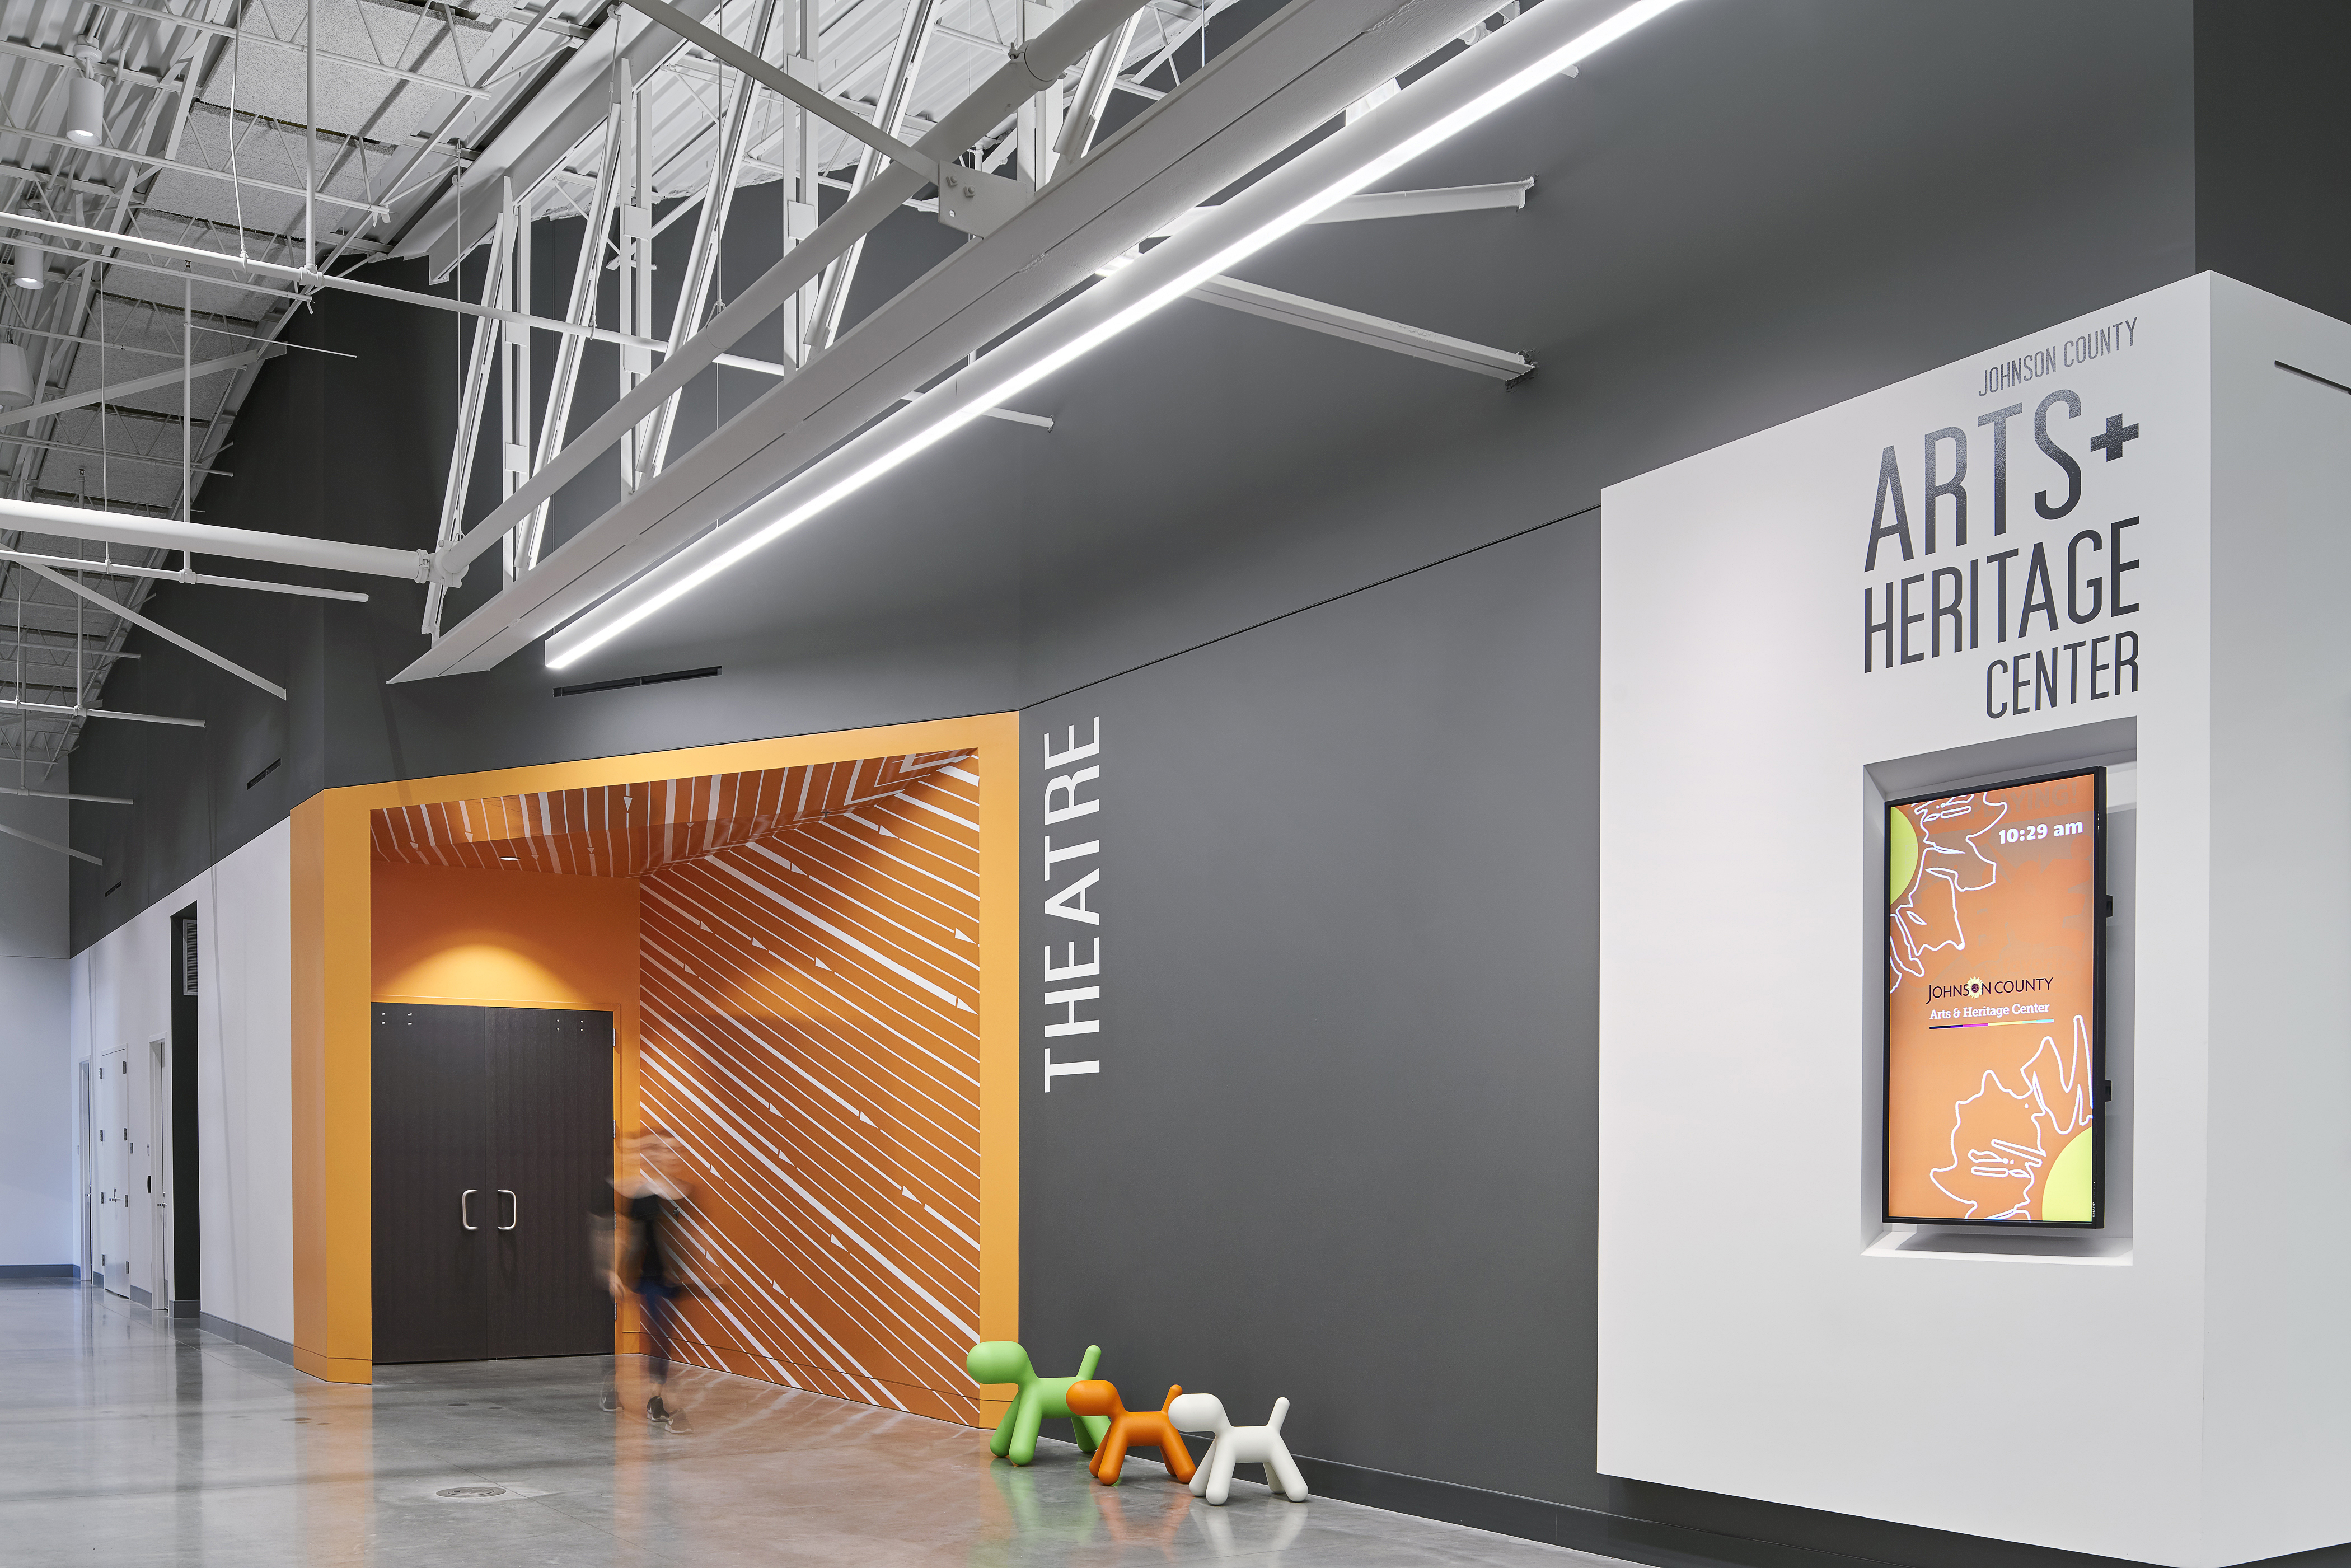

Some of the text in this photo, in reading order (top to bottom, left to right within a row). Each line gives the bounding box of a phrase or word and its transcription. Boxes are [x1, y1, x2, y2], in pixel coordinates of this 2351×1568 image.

[1978, 316, 2138, 397] JOHNSON COUNTY
[1865, 389, 2139, 573] ARTS+
[1865, 516, 2139, 673] HERITAGE
[1987, 630, 2139, 719] CENTER
[1999, 821, 2083, 844] 10:29 am
[1044, 716, 1100, 1093] THEATRE
[1929, 1003, 2050, 1020] Arts & Heritage Center
[1994, 977, 2054, 994] COUNTY
